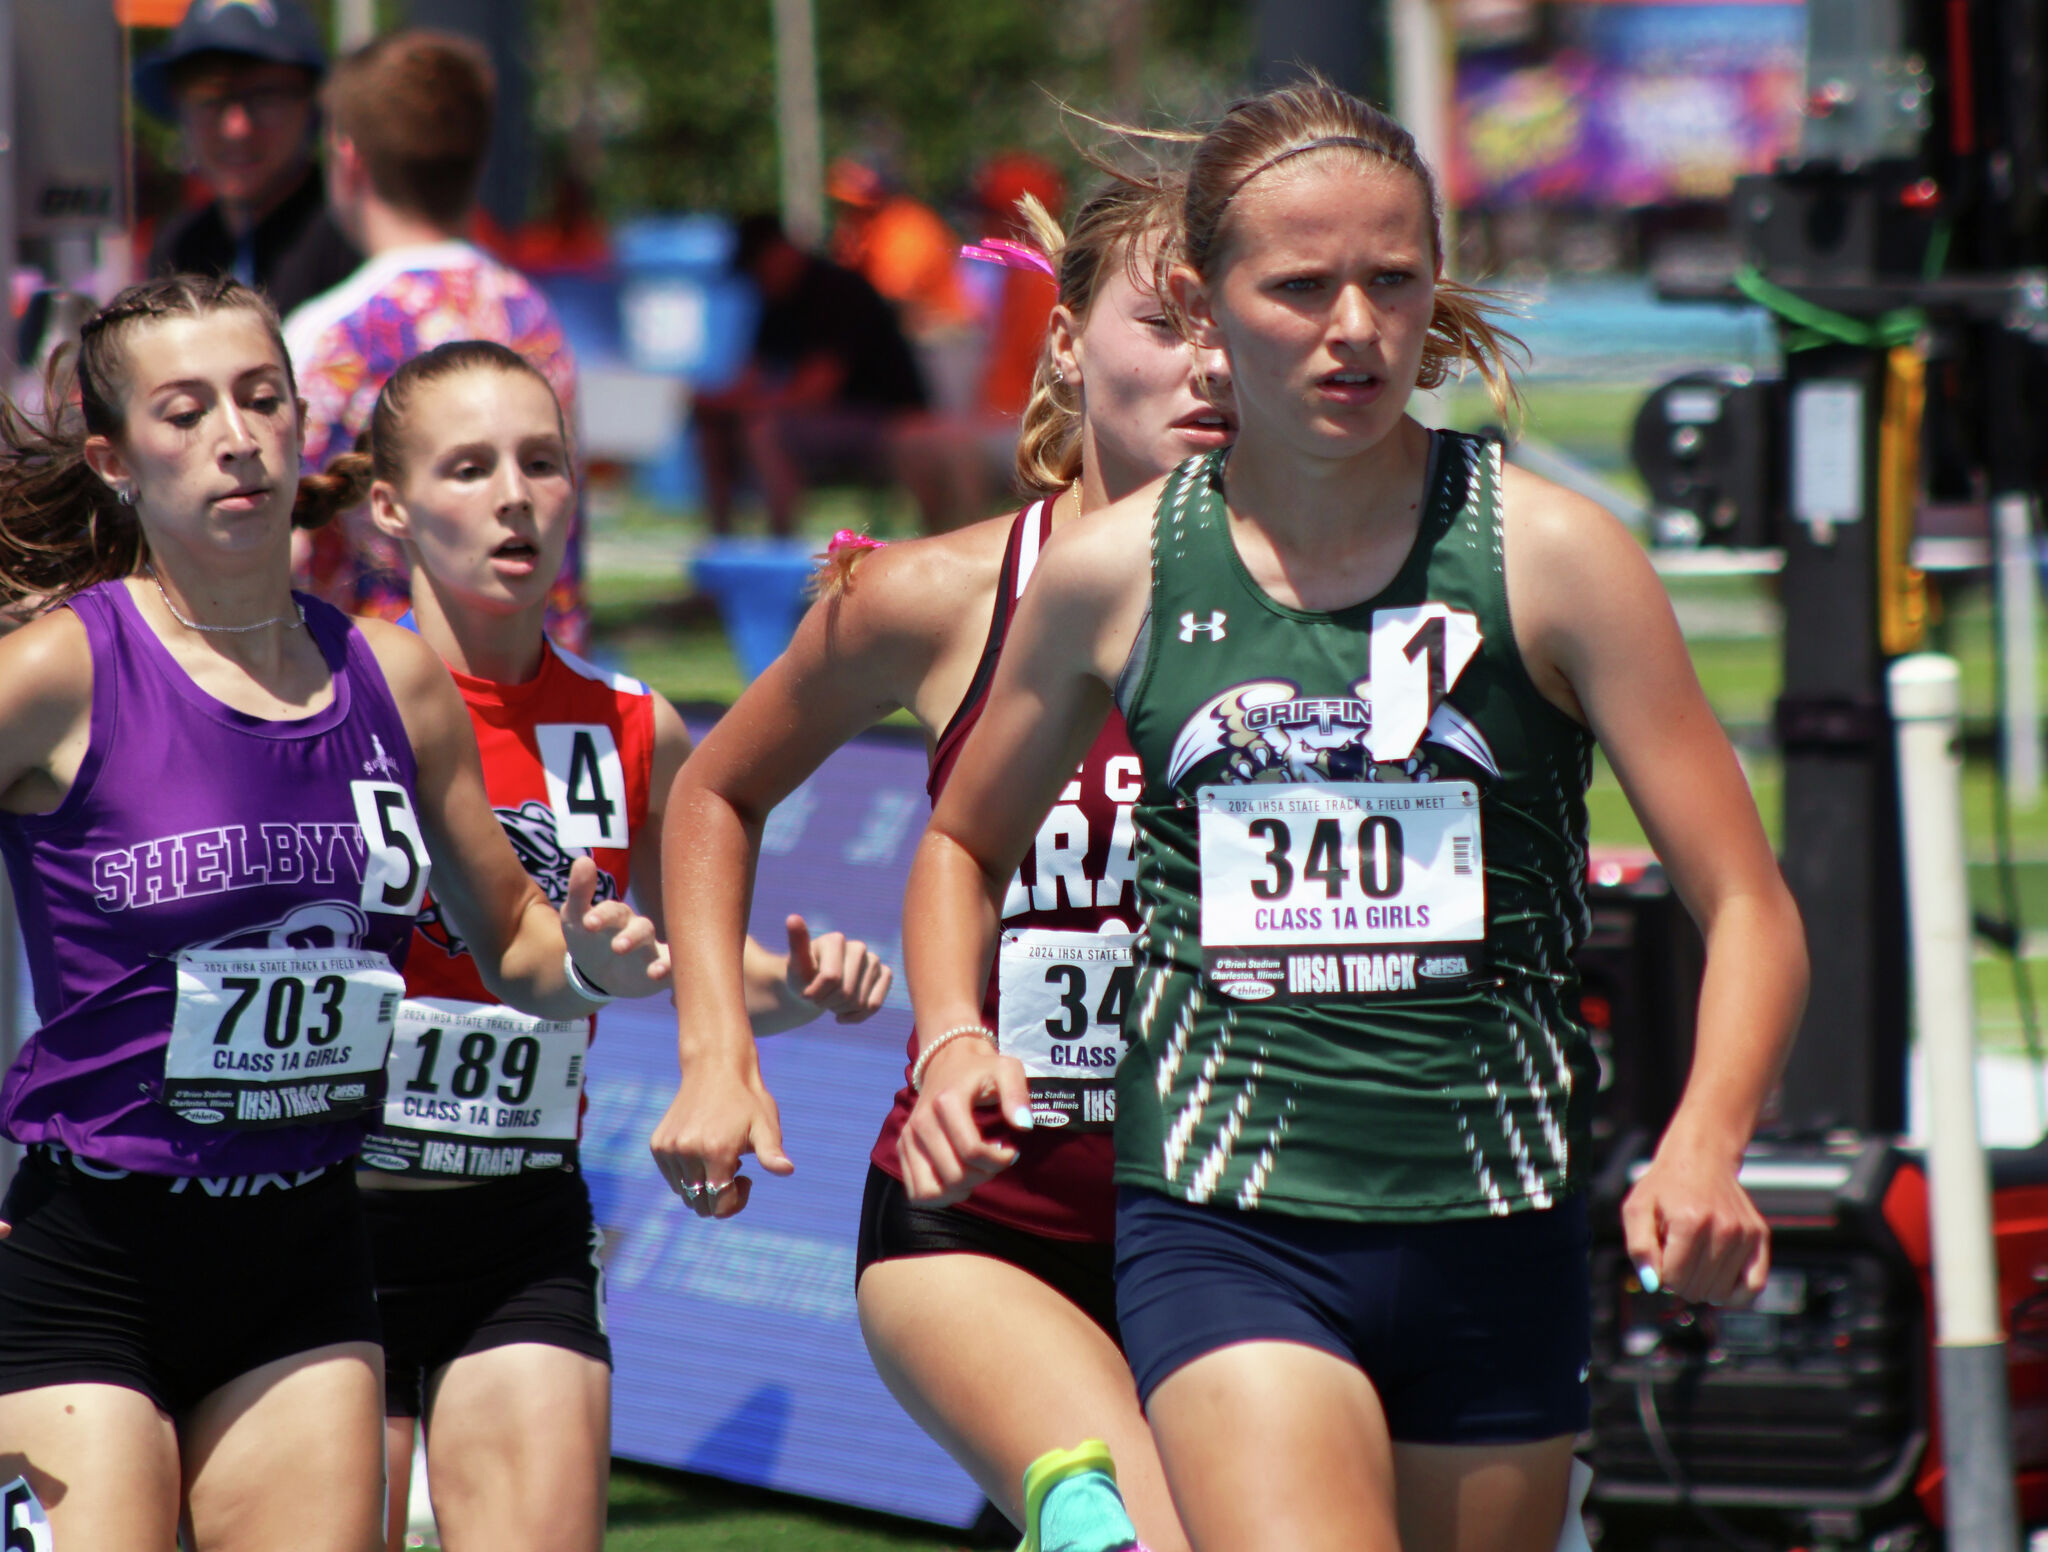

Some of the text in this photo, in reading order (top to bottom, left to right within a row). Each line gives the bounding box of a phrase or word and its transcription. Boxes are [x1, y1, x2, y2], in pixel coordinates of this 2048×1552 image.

[1403, 617, 1446, 725] 1
[567, 731, 616, 838] 4
[1229, 798, 1445, 813] 2024 IHSA STATE TRACK & FIELD MEET
[373, 790, 420, 907] 5
[1001, 804, 1137, 919] RA
[1248, 815, 1405, 900] 340
[1255, 904, 1430, 931] CLASS 1A GIRLS
[232, 962, 255, 973] IHSA
[260, 961, 287, 973] STATE
[291, 960, 319, 972] TRACK
[330, 959, 355, 970] FIELD
[357, 959, 377, 969] MEET
[1029, 947, 1053, 958] 2024
[1058, 948, 1083, 960] IHSA
[1088, 949, 1118, 960] STATE
[1216, 959, 1281, 969] O'Brien Stadium
[1211, 971, 1285, 980] Charleston, Illinois
[1288, 953, 1417, 993] IHSA TRACK
[213, 975, 347, 1049] 703
[404, 1010, 426, 1020] 2024
[430, 1012, 451, 1024] IHSA
[456, 1015, 481, 1029] STATE
[486, 1019, 514, 1031] TRACK
[213, 1046, 352, 1072] CLASS 1A GIRLS
[406, 1028, 541, 1106] 189
[1050, 1044, 1117, 1068] CLASS
[238, 1083, 331, 1121] IHSA TRACK
[1044, 1091, 1076, 1099] Stadium
[1053, 1101, 1080, 1110] Illinois
[403, 1096, 542, 1128] CLASS 1A GIRLS
[420, 1141, 467, 1174] IHSA
[467, 1146, 524, 1176] TRACK
